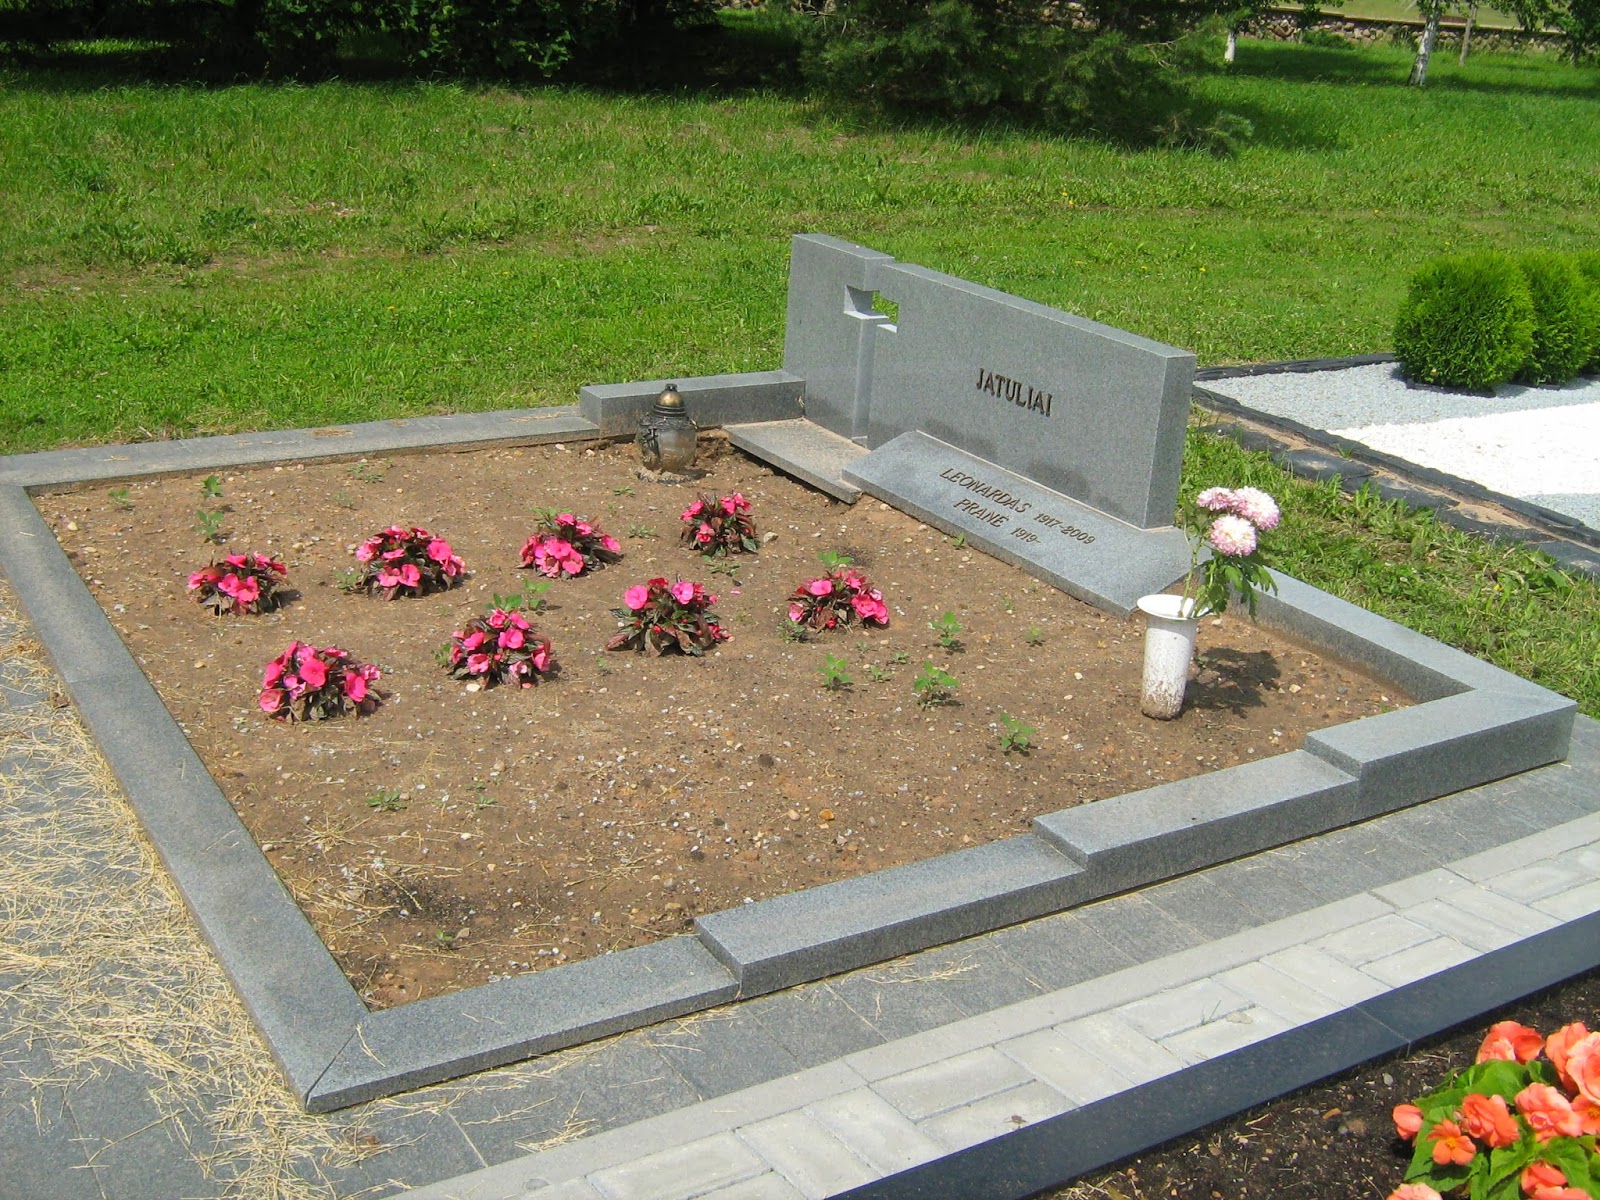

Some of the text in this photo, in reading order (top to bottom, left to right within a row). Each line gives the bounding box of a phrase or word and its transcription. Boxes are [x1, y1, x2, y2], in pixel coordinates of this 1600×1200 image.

[976, 368, 1053, 417] JATULIAI
[940, 468, 1096, 545] LEONARDAS 1917-2009
